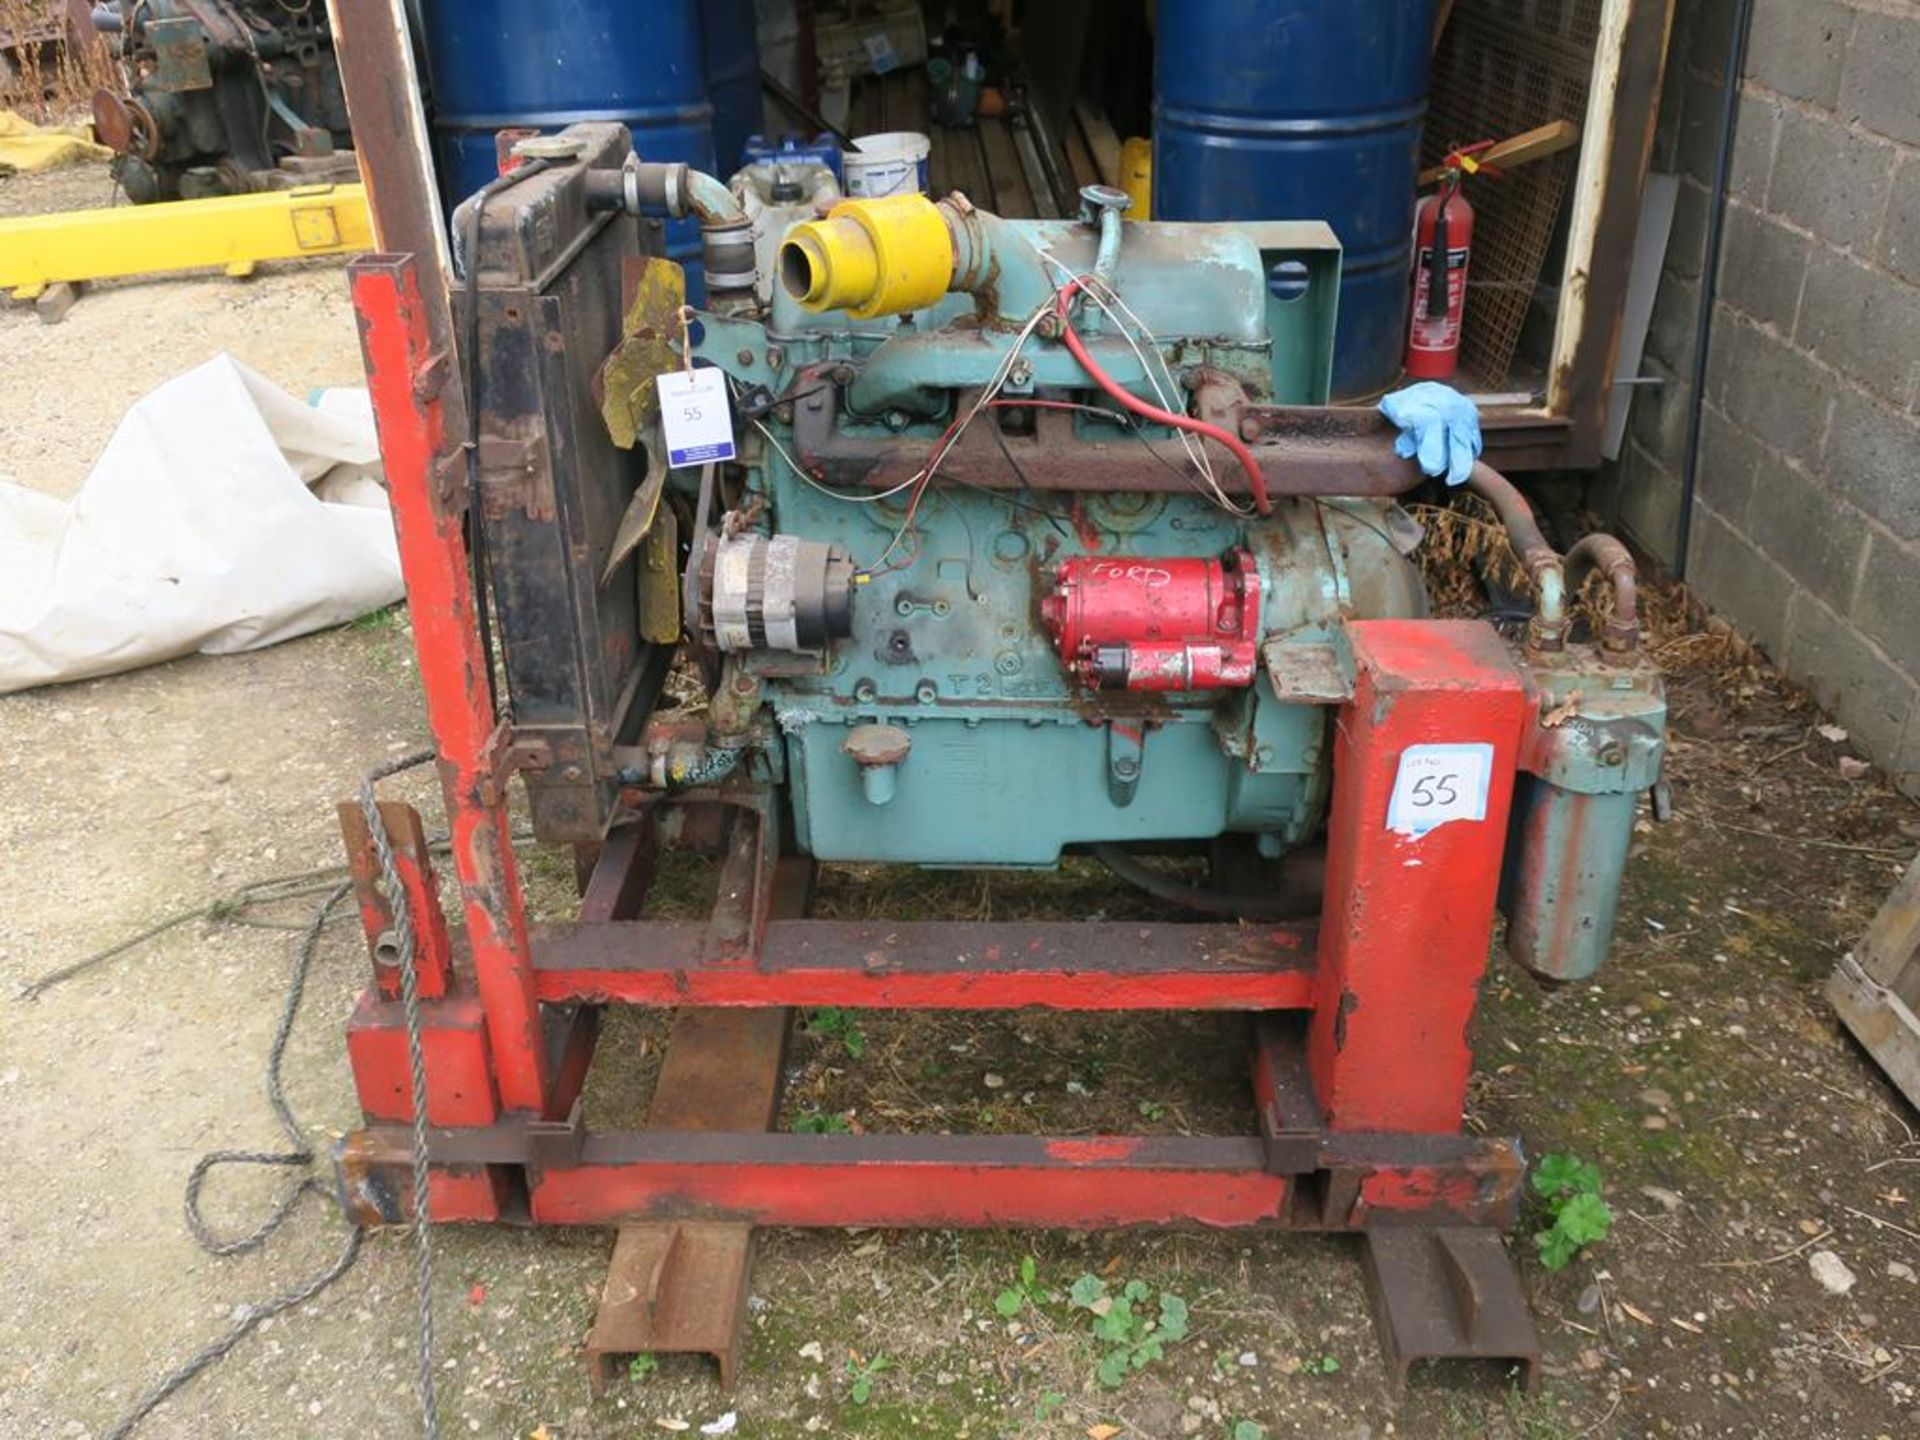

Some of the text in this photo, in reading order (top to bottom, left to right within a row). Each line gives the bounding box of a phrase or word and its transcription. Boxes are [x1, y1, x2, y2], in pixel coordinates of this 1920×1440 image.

[683, 406, 703, 421] 55
[1092, 563, 1171, 586] FORD
[1411, 774, 1458, 807] 55
